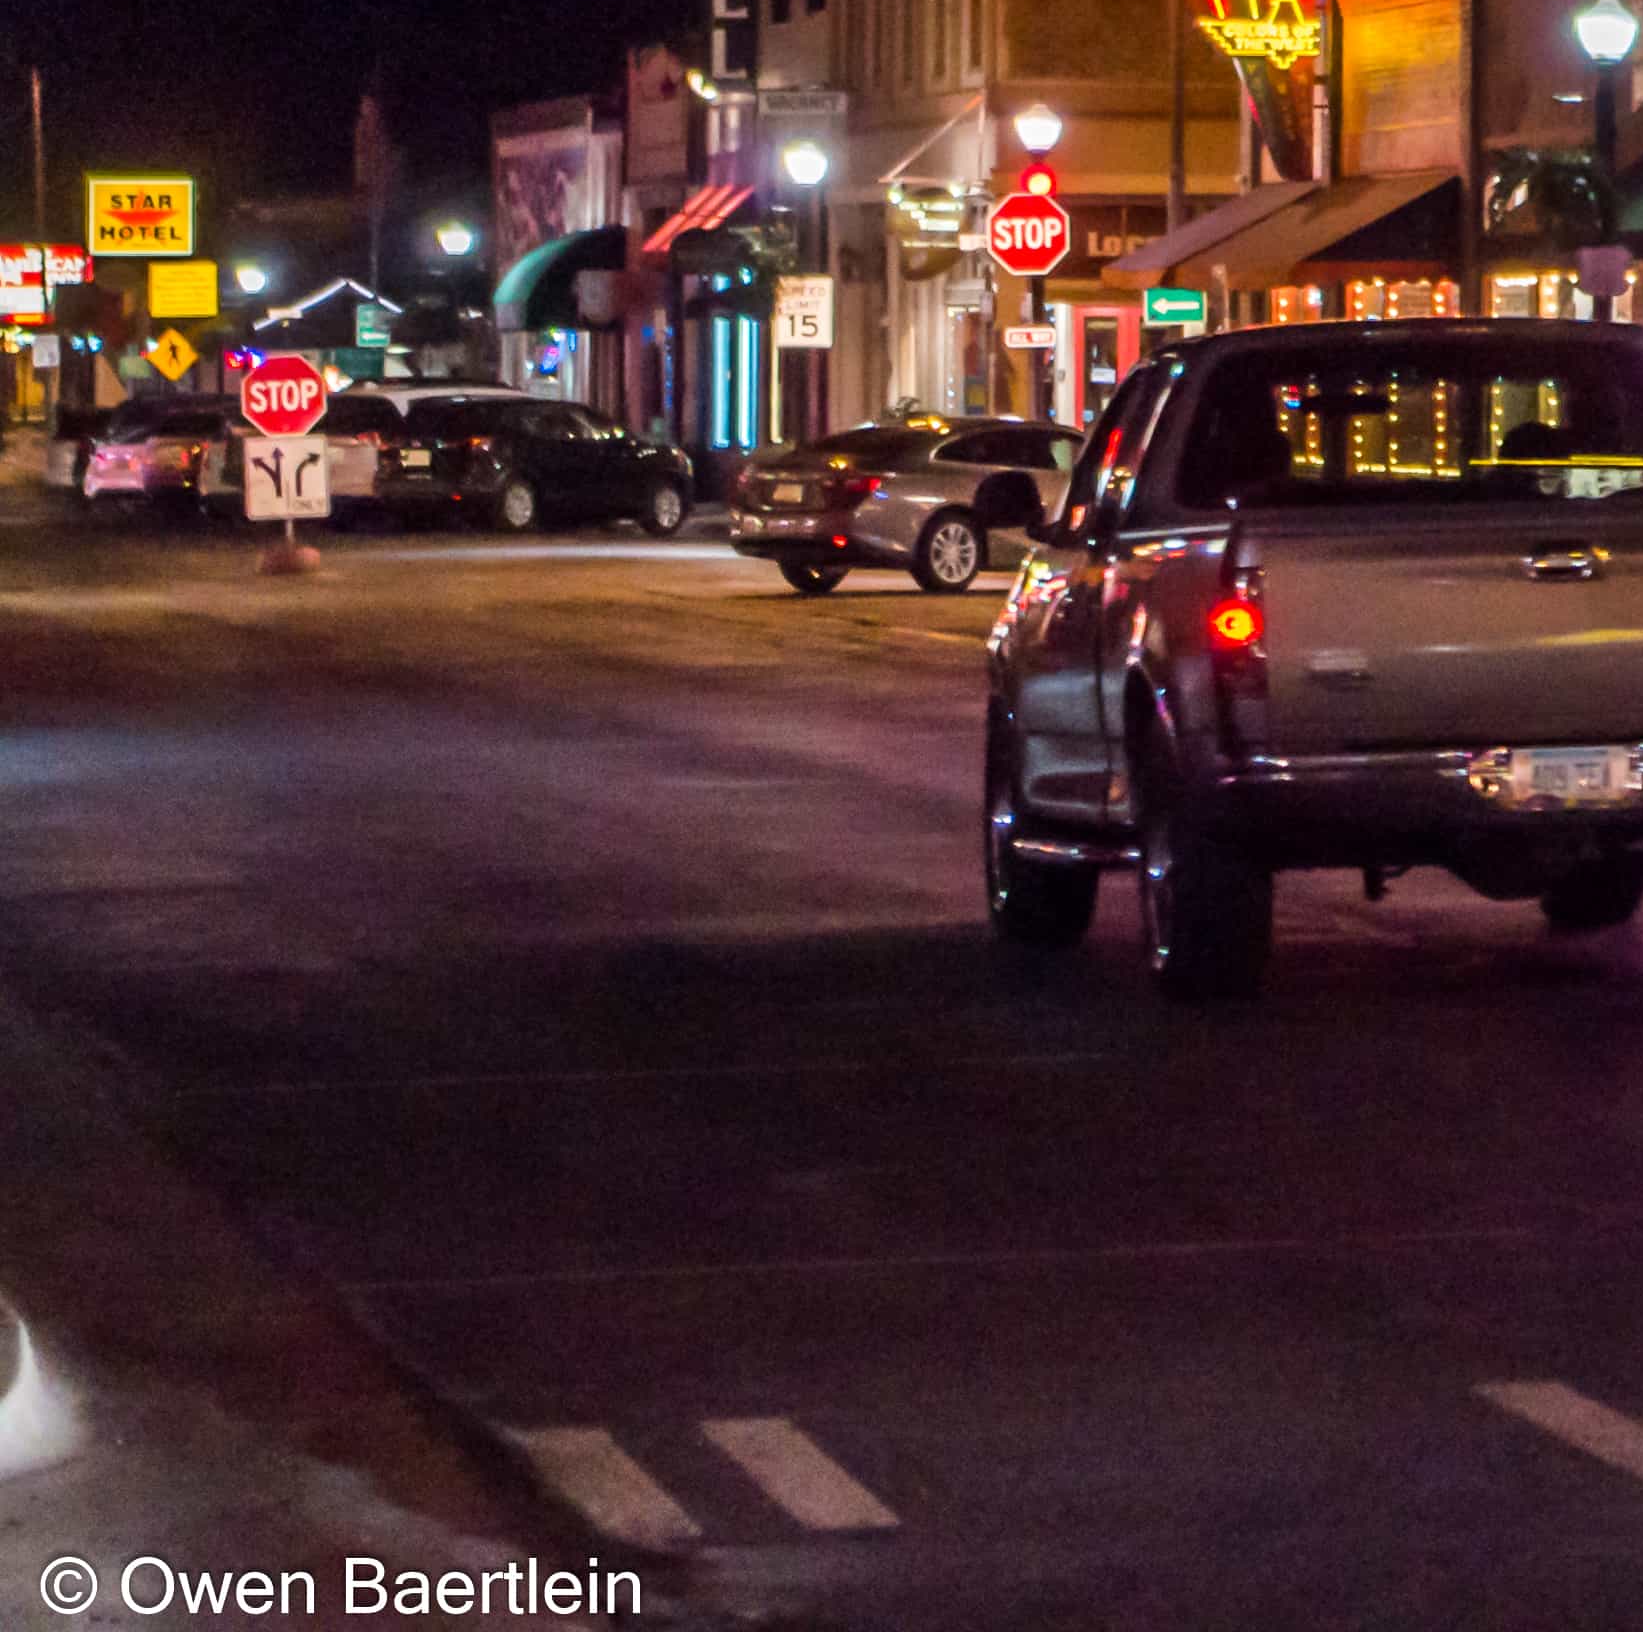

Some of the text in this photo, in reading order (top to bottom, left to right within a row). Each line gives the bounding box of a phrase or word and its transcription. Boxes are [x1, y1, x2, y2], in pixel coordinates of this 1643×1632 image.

[111, 194, 172, 209] STAR
[994, 217, 1062, 250] STOP
[788, 314, 820, 337] 15
[250, 378, 319, 414] STOP
